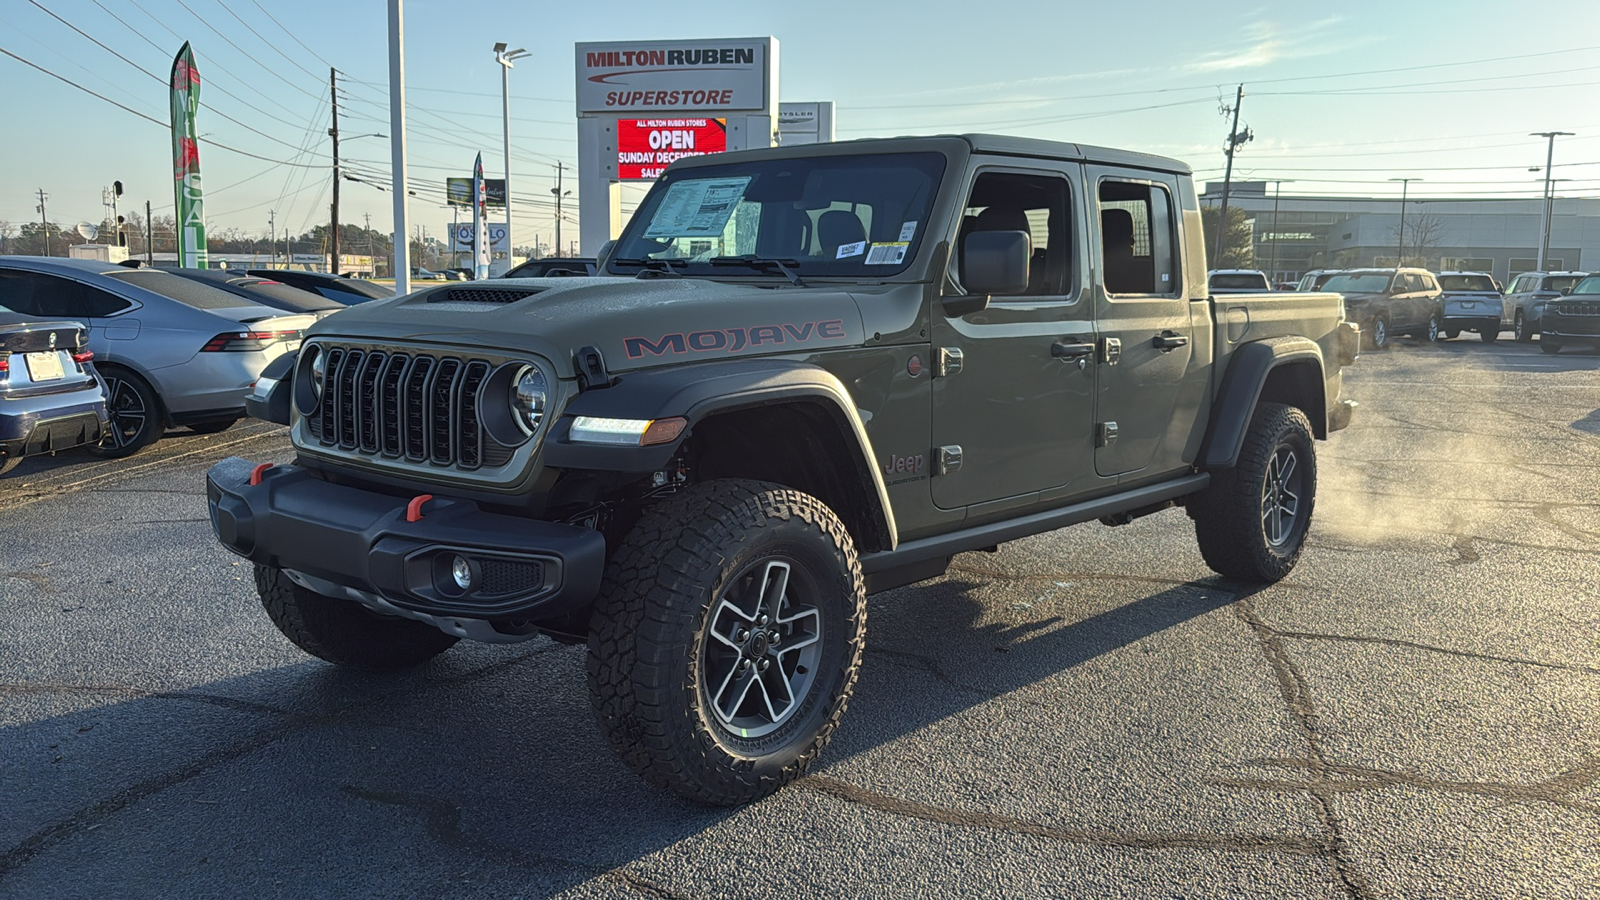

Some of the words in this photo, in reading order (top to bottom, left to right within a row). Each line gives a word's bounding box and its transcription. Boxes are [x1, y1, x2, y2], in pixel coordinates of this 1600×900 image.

[587, 50, 665, 67] MILTON
[667, 48, 753, 65] RUBEN
[605, 90, 733, 106] SUPERSTORE
[686, 119, 707, 127] STORES
[648, 130, 695, 150] OPEN
[618, 152, 655, 163] SUNDAY
[623, 319, 846, 358] MOJAVE
[884, 454, 923, 475] Jeep
